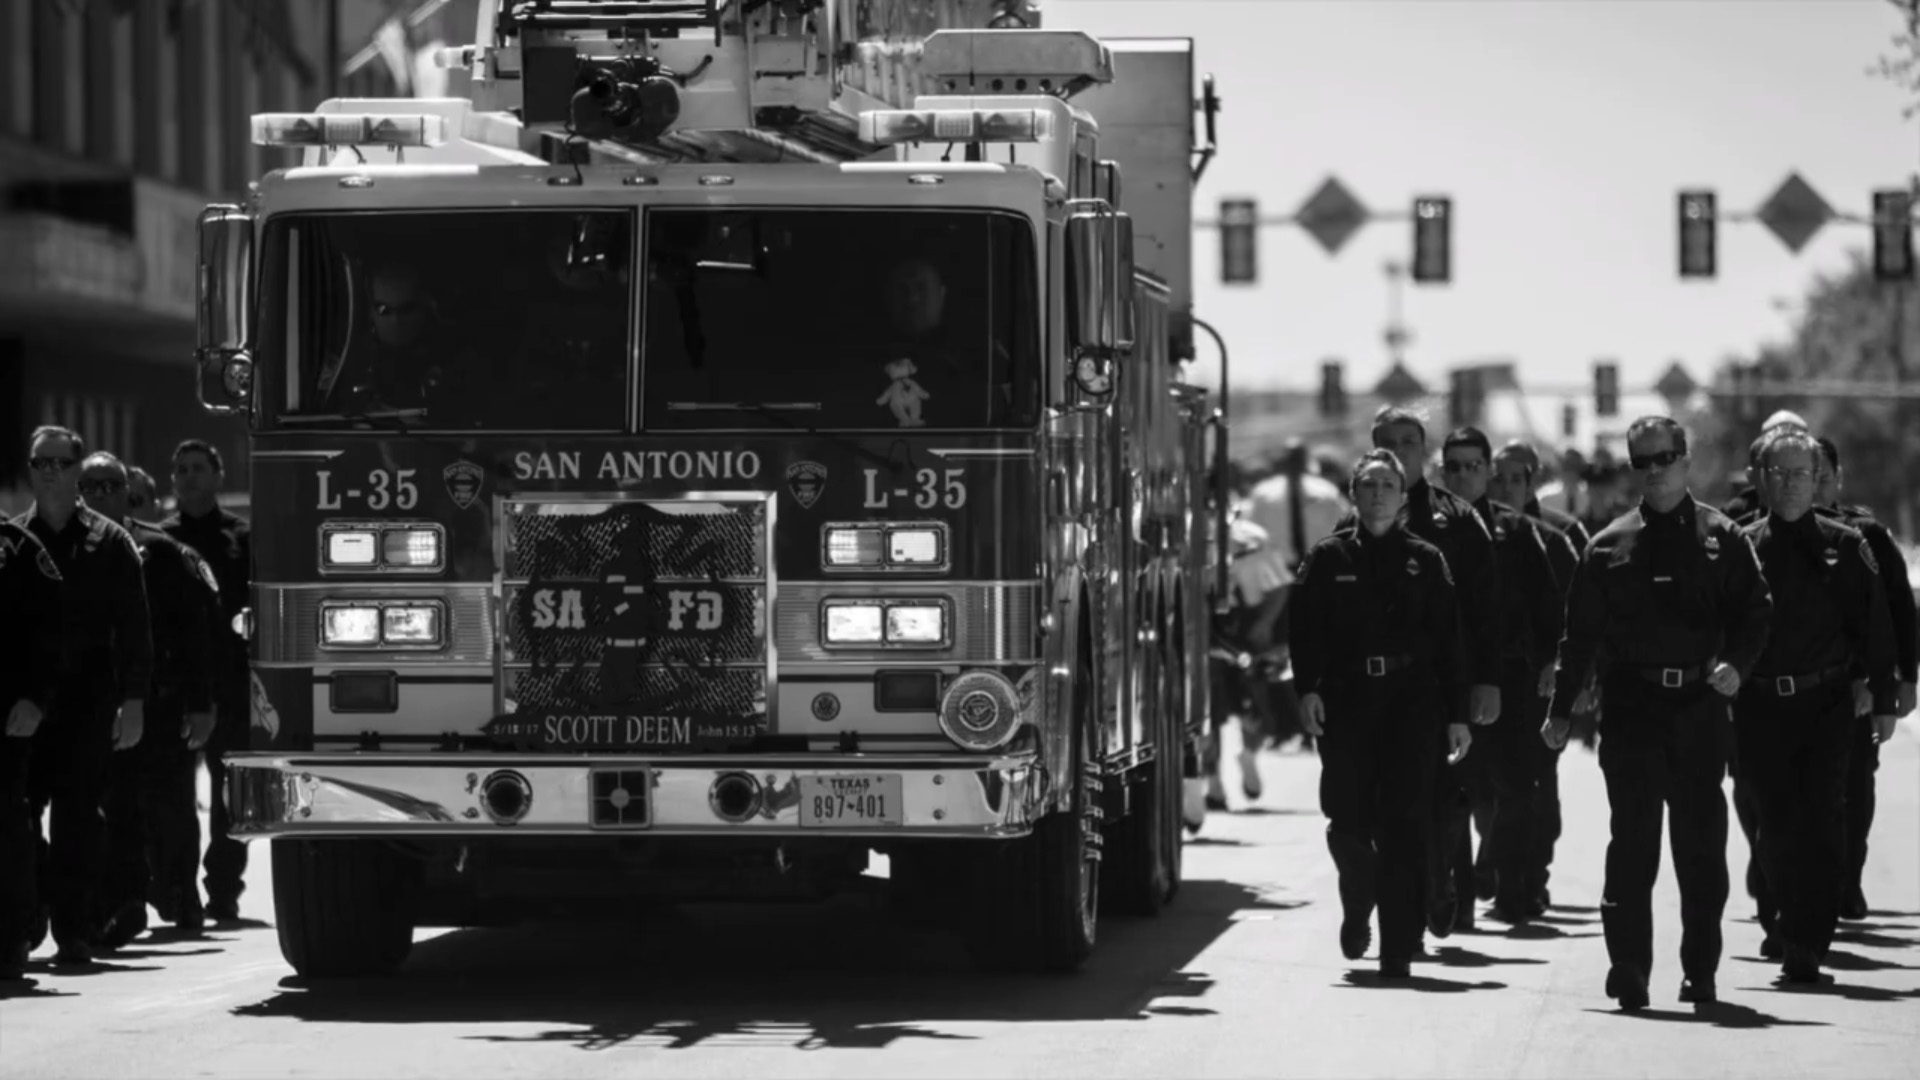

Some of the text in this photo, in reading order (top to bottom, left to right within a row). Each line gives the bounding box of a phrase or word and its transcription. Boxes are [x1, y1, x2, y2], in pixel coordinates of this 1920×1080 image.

[514, 451, 581, 480] SAN
[597, 450, 761, 479] ANTONIO
[316, 469, 418, 510] L-35
[863, 468, 967, 509] L-35
[532, 589, 723, 631] SA FD
[544, 715, 618, 744] SCOTT
[626, 715, 691, 744] DEEM
[830, 778, 870, 789] TEXAS
